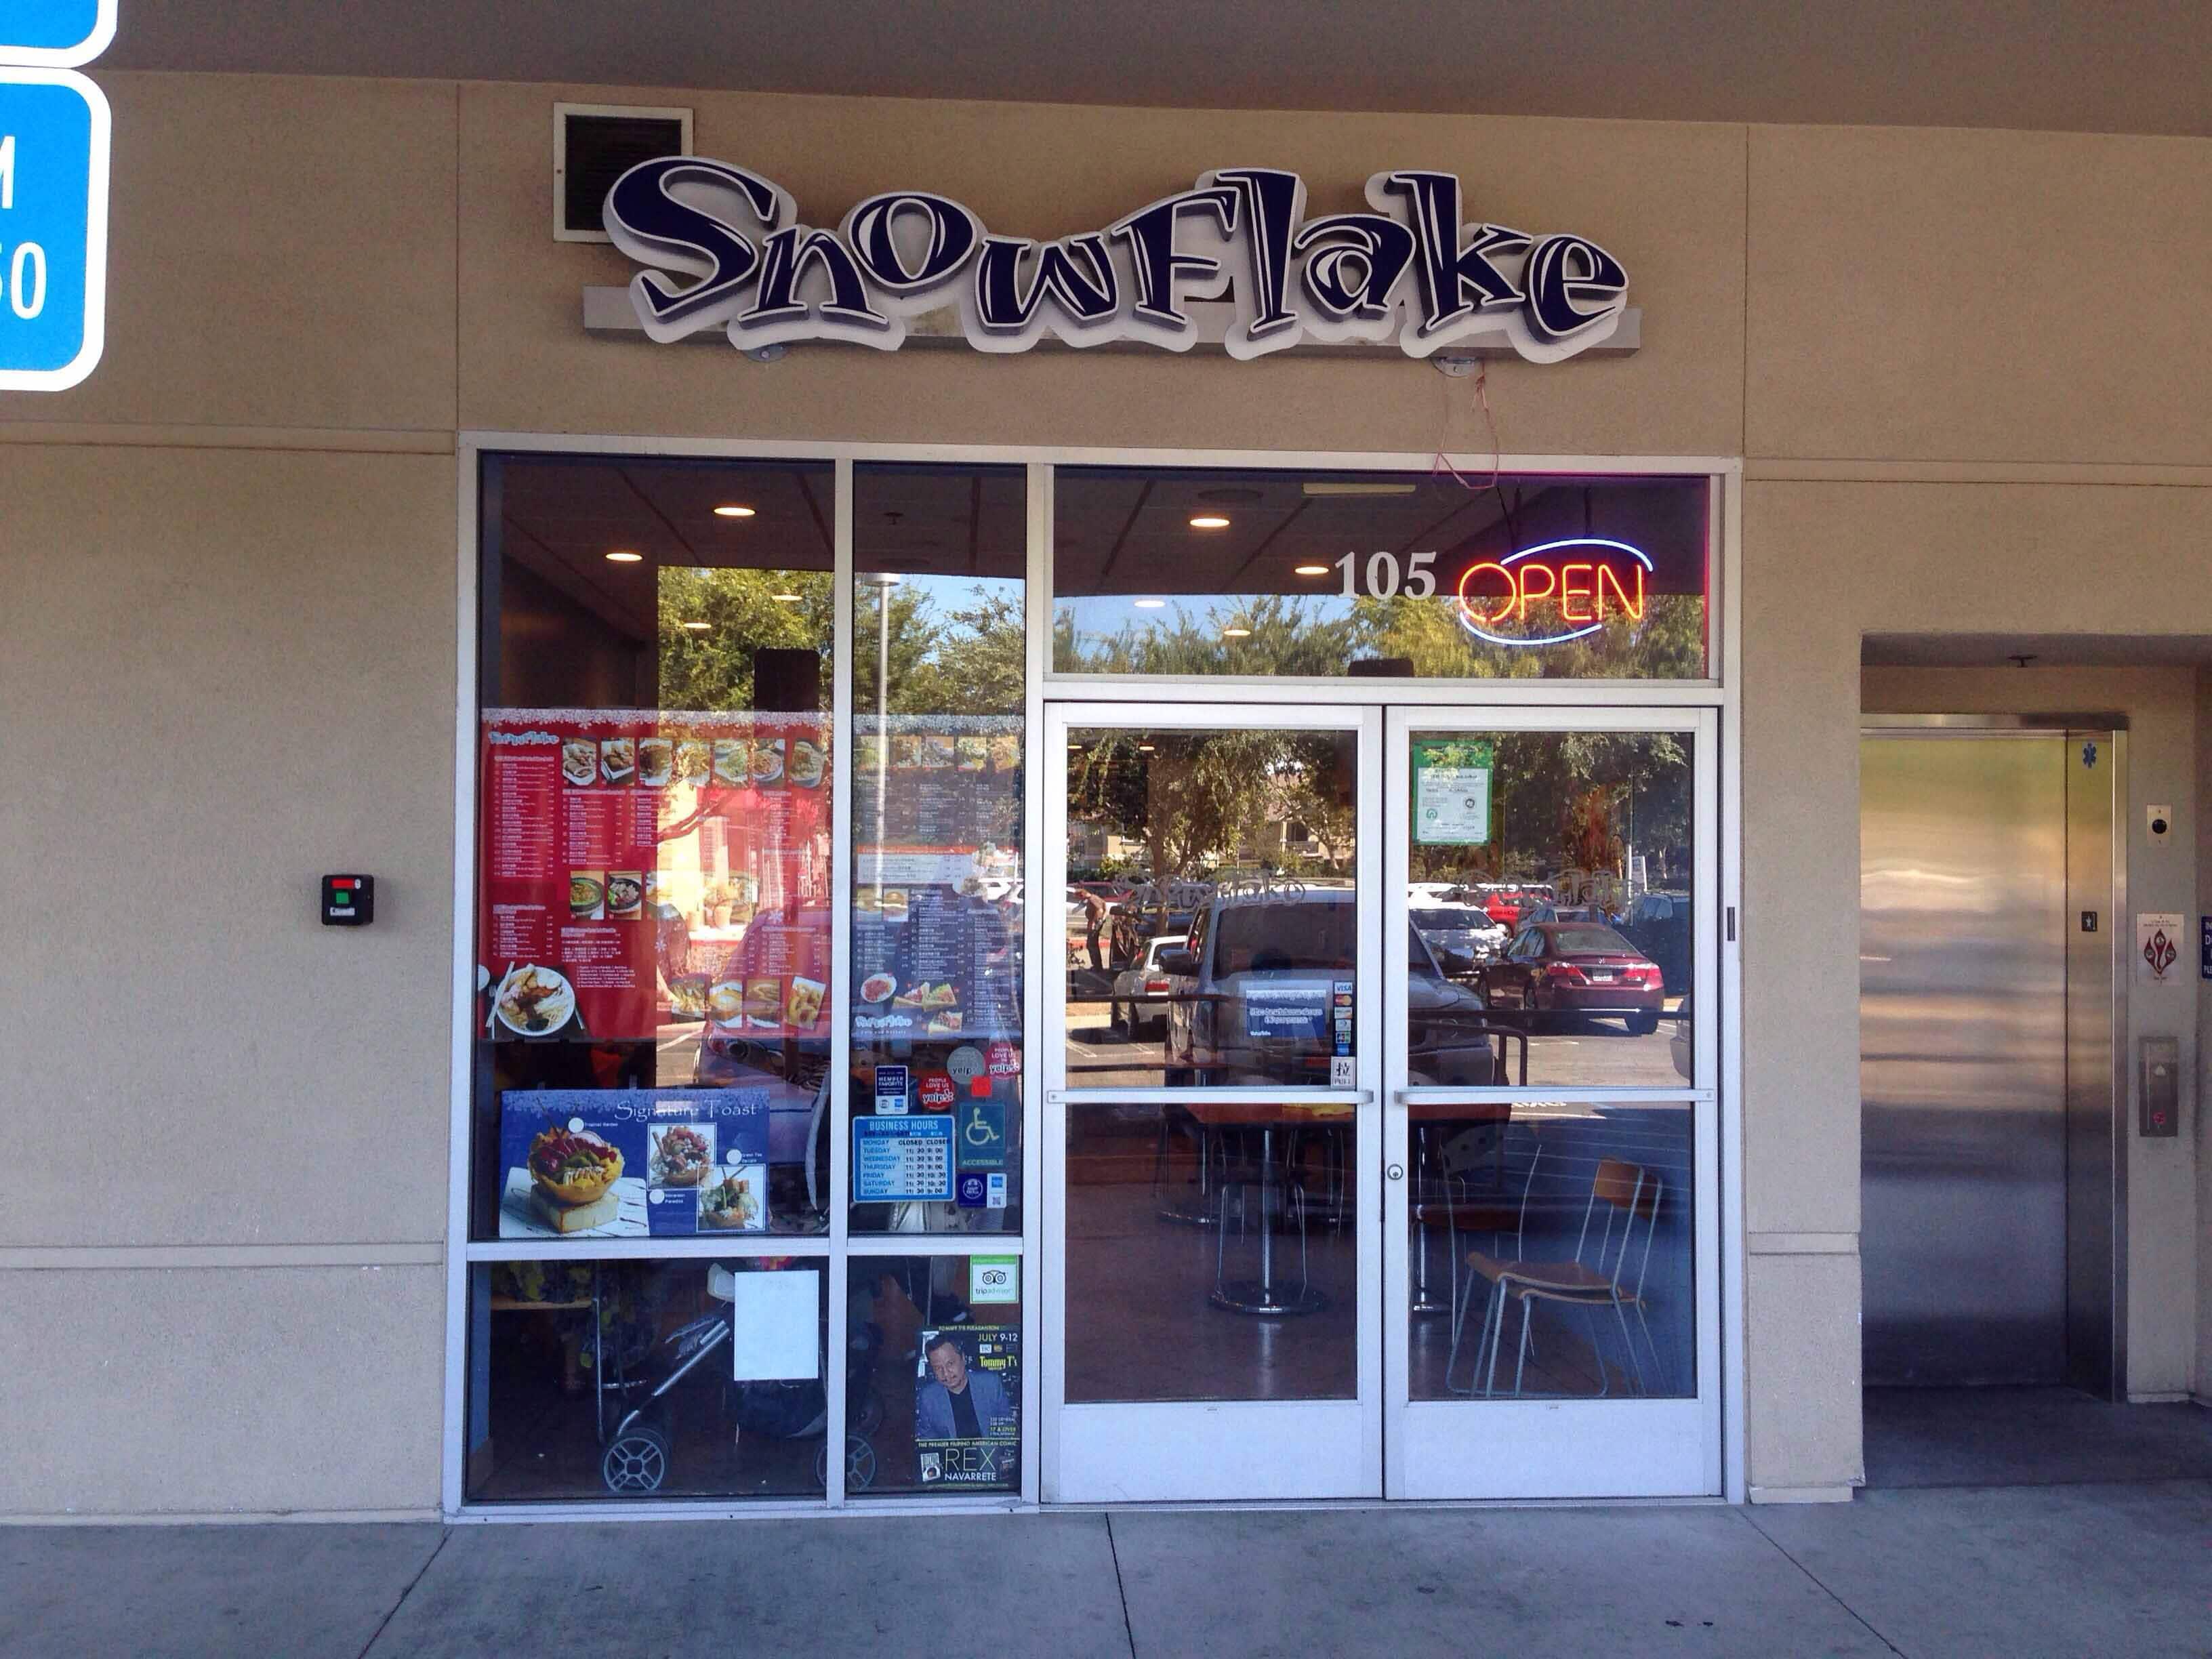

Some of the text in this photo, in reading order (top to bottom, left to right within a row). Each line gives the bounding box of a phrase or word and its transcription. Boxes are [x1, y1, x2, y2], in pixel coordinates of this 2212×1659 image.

[1334, 552, 1437, 600] 105
[1458, 562, 1644, 622] OPEN
[952, 1065, 972, 1076] yelp
[989, 1063, 1010, 1074] yelp
[922, 1092, 944, 1105] yelp
[613, 1099, 699, 1123] Signature
[869, 1120, 939, 1131] BUSINESS HOURS
[978, 1332, 1019, 1343] JULY 9-12
[979, 1355, 1018, 1371] Tommy T's
[945, 1447, 996, 1472] REX
[944, 1472, 998, 1481] NAVARRETE
